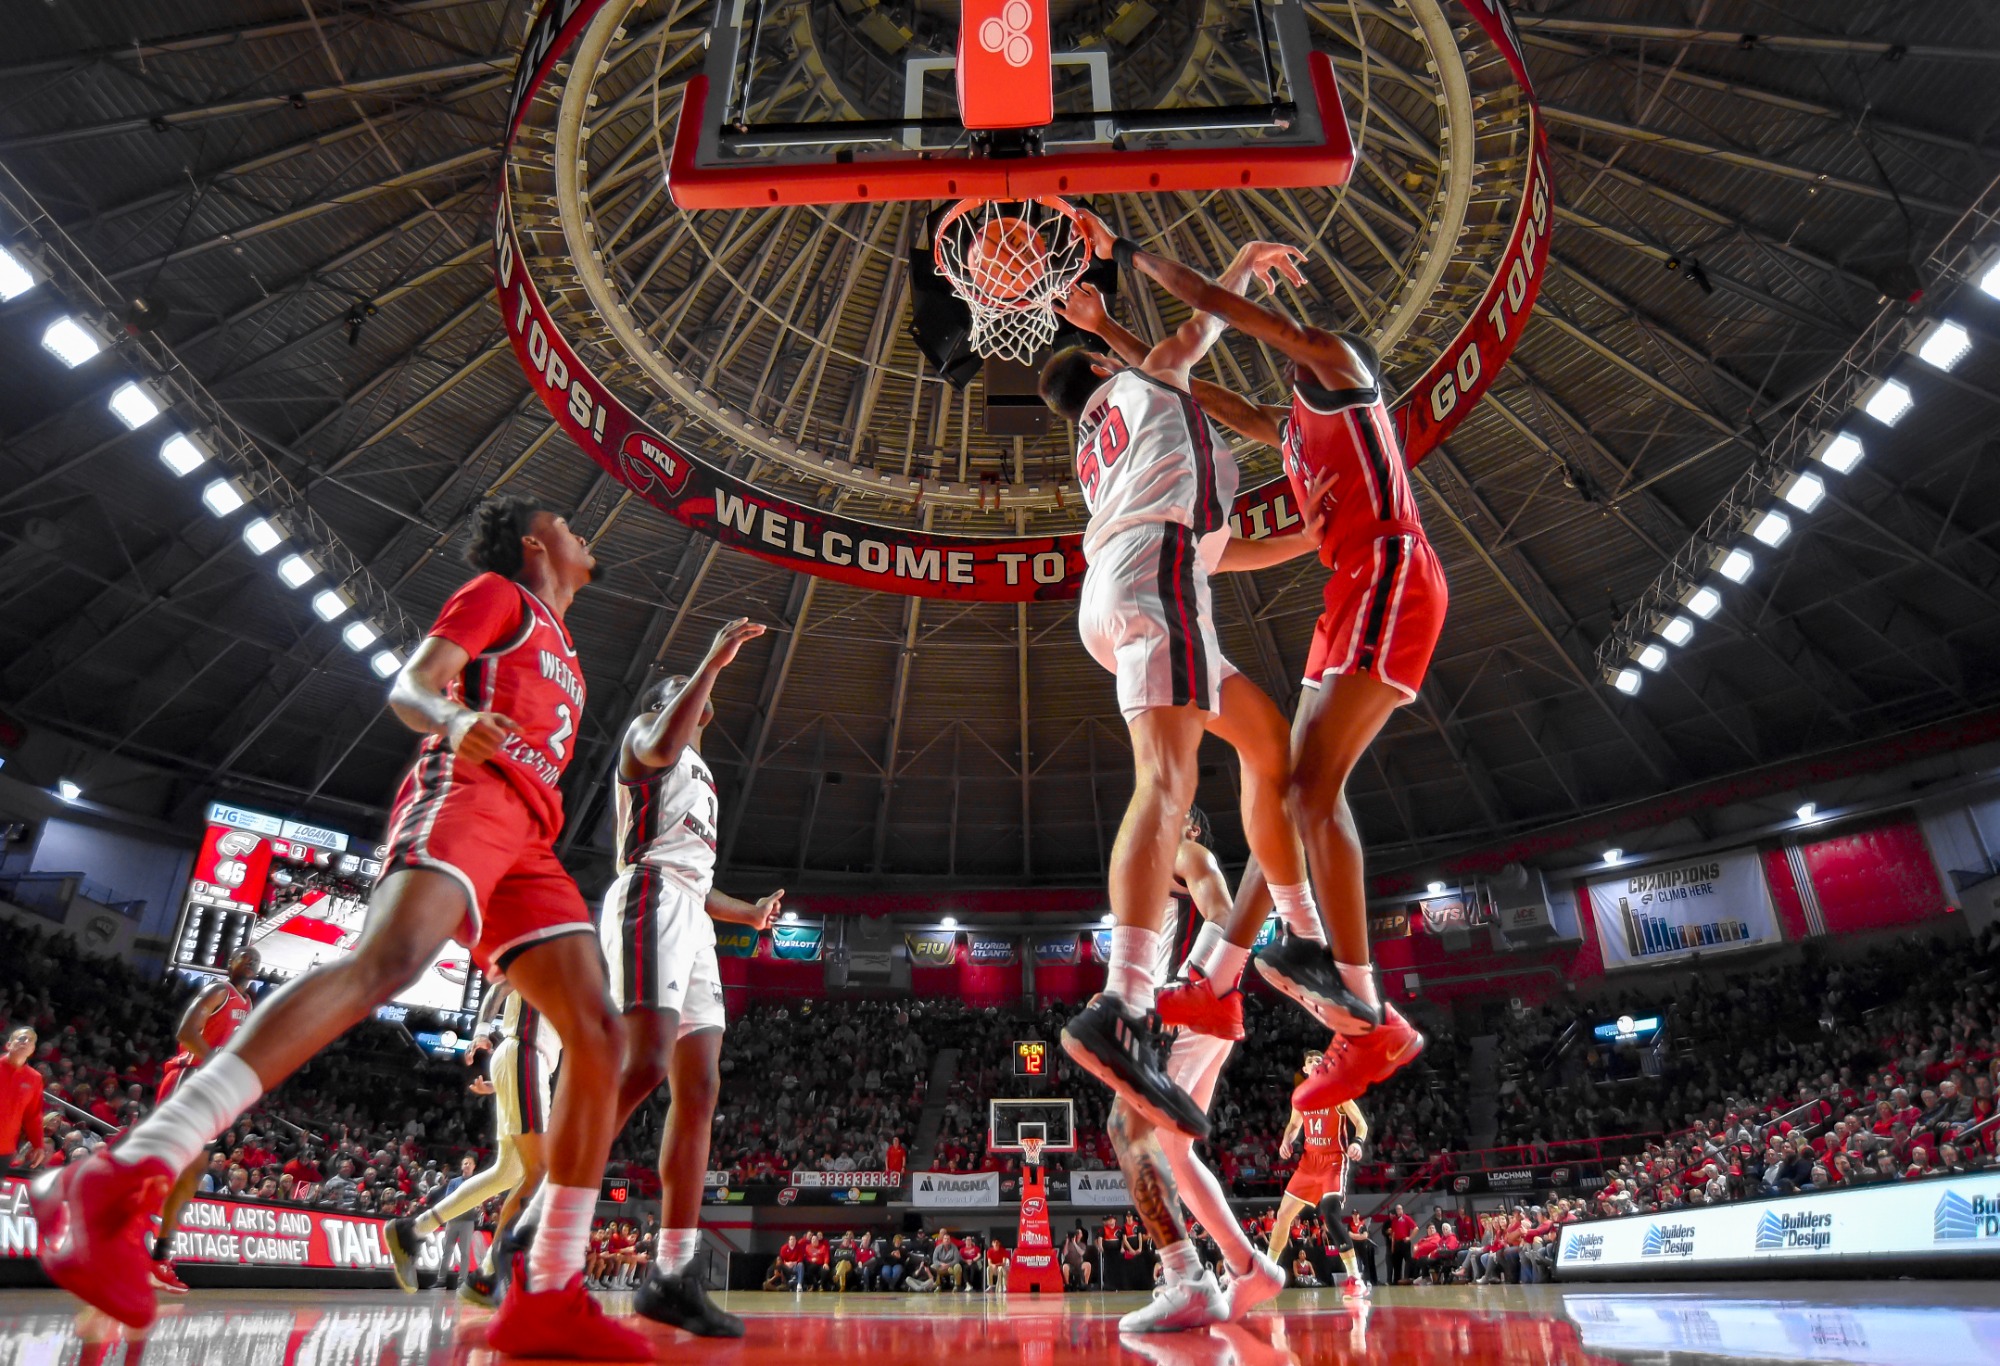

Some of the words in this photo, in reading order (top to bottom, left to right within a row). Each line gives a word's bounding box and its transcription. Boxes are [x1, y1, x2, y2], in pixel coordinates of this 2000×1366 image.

[1430, 342, 1482, 423] GO
[1488, 153, 1549, 343] TOPS!
[496, 191, 513, 289] GO
[517, 295, 606, 444] TOPS!
[641, 439, 677, 477] WKU
[1077, 405, 1130, 504] 50
[714, 487, 975, 585] WELCOME
[997, 552, 1065, 585] TO
[549, 703, 573, 760] 2
[214, 807, 238, 822] HG
[295, 826, 330, 841] LOGAN
[216, 860, 247, 885] 46
[1628, 863, 1720, 894] CHAMPIONS
[1658, 886, 1687, 903] CLIMB
[1689, 882, 1713, 897] HERE
[1513, 907, 1536, 920] ACE
[1373, 915, 1405, 930] TEP
[717, 935, 750, 947] UAB
[774, 939, 818, 949] CHARLOTT
[916, 942, 945, 955] FIU
[973, 941, 1011, 950] FLORIDA
[1035, 945, 1048, 953] LA
[1050, 944, 1076, 953] TECH
[971, 949, 1014, 958] ATLANTIC
[1020, 1045, 1043, 1055] 15:04
[1027, 1055, 1040, 1072] 12
[1308, 1117, 1323, 1135] 14
[1487, 1169, 1532, 1181] LEACHMAN
[937, 1180, 991, 1192] MAGNA
[1095, 1178, 1127, 1190] MAG
[612, 1188, 626, 1201] 48
[184, 1202, 232, 1231] RISM,
[235, 1207, 277, 1232] ARTS
[281, 1212, 312, 1235] AND
[1781, 1209, 1832, 1230] Builders
[1578, 1233, 1604, 1246] Builders
[1660, 1224, 1696, 1240] Builders
[1788, 1228, 1831, 1250] Design
[244, 1236, 310, 1261] CABINET
[1579, 1245, 1602, 1261] Design
[1663, 1238, 1694, 1256] Design
